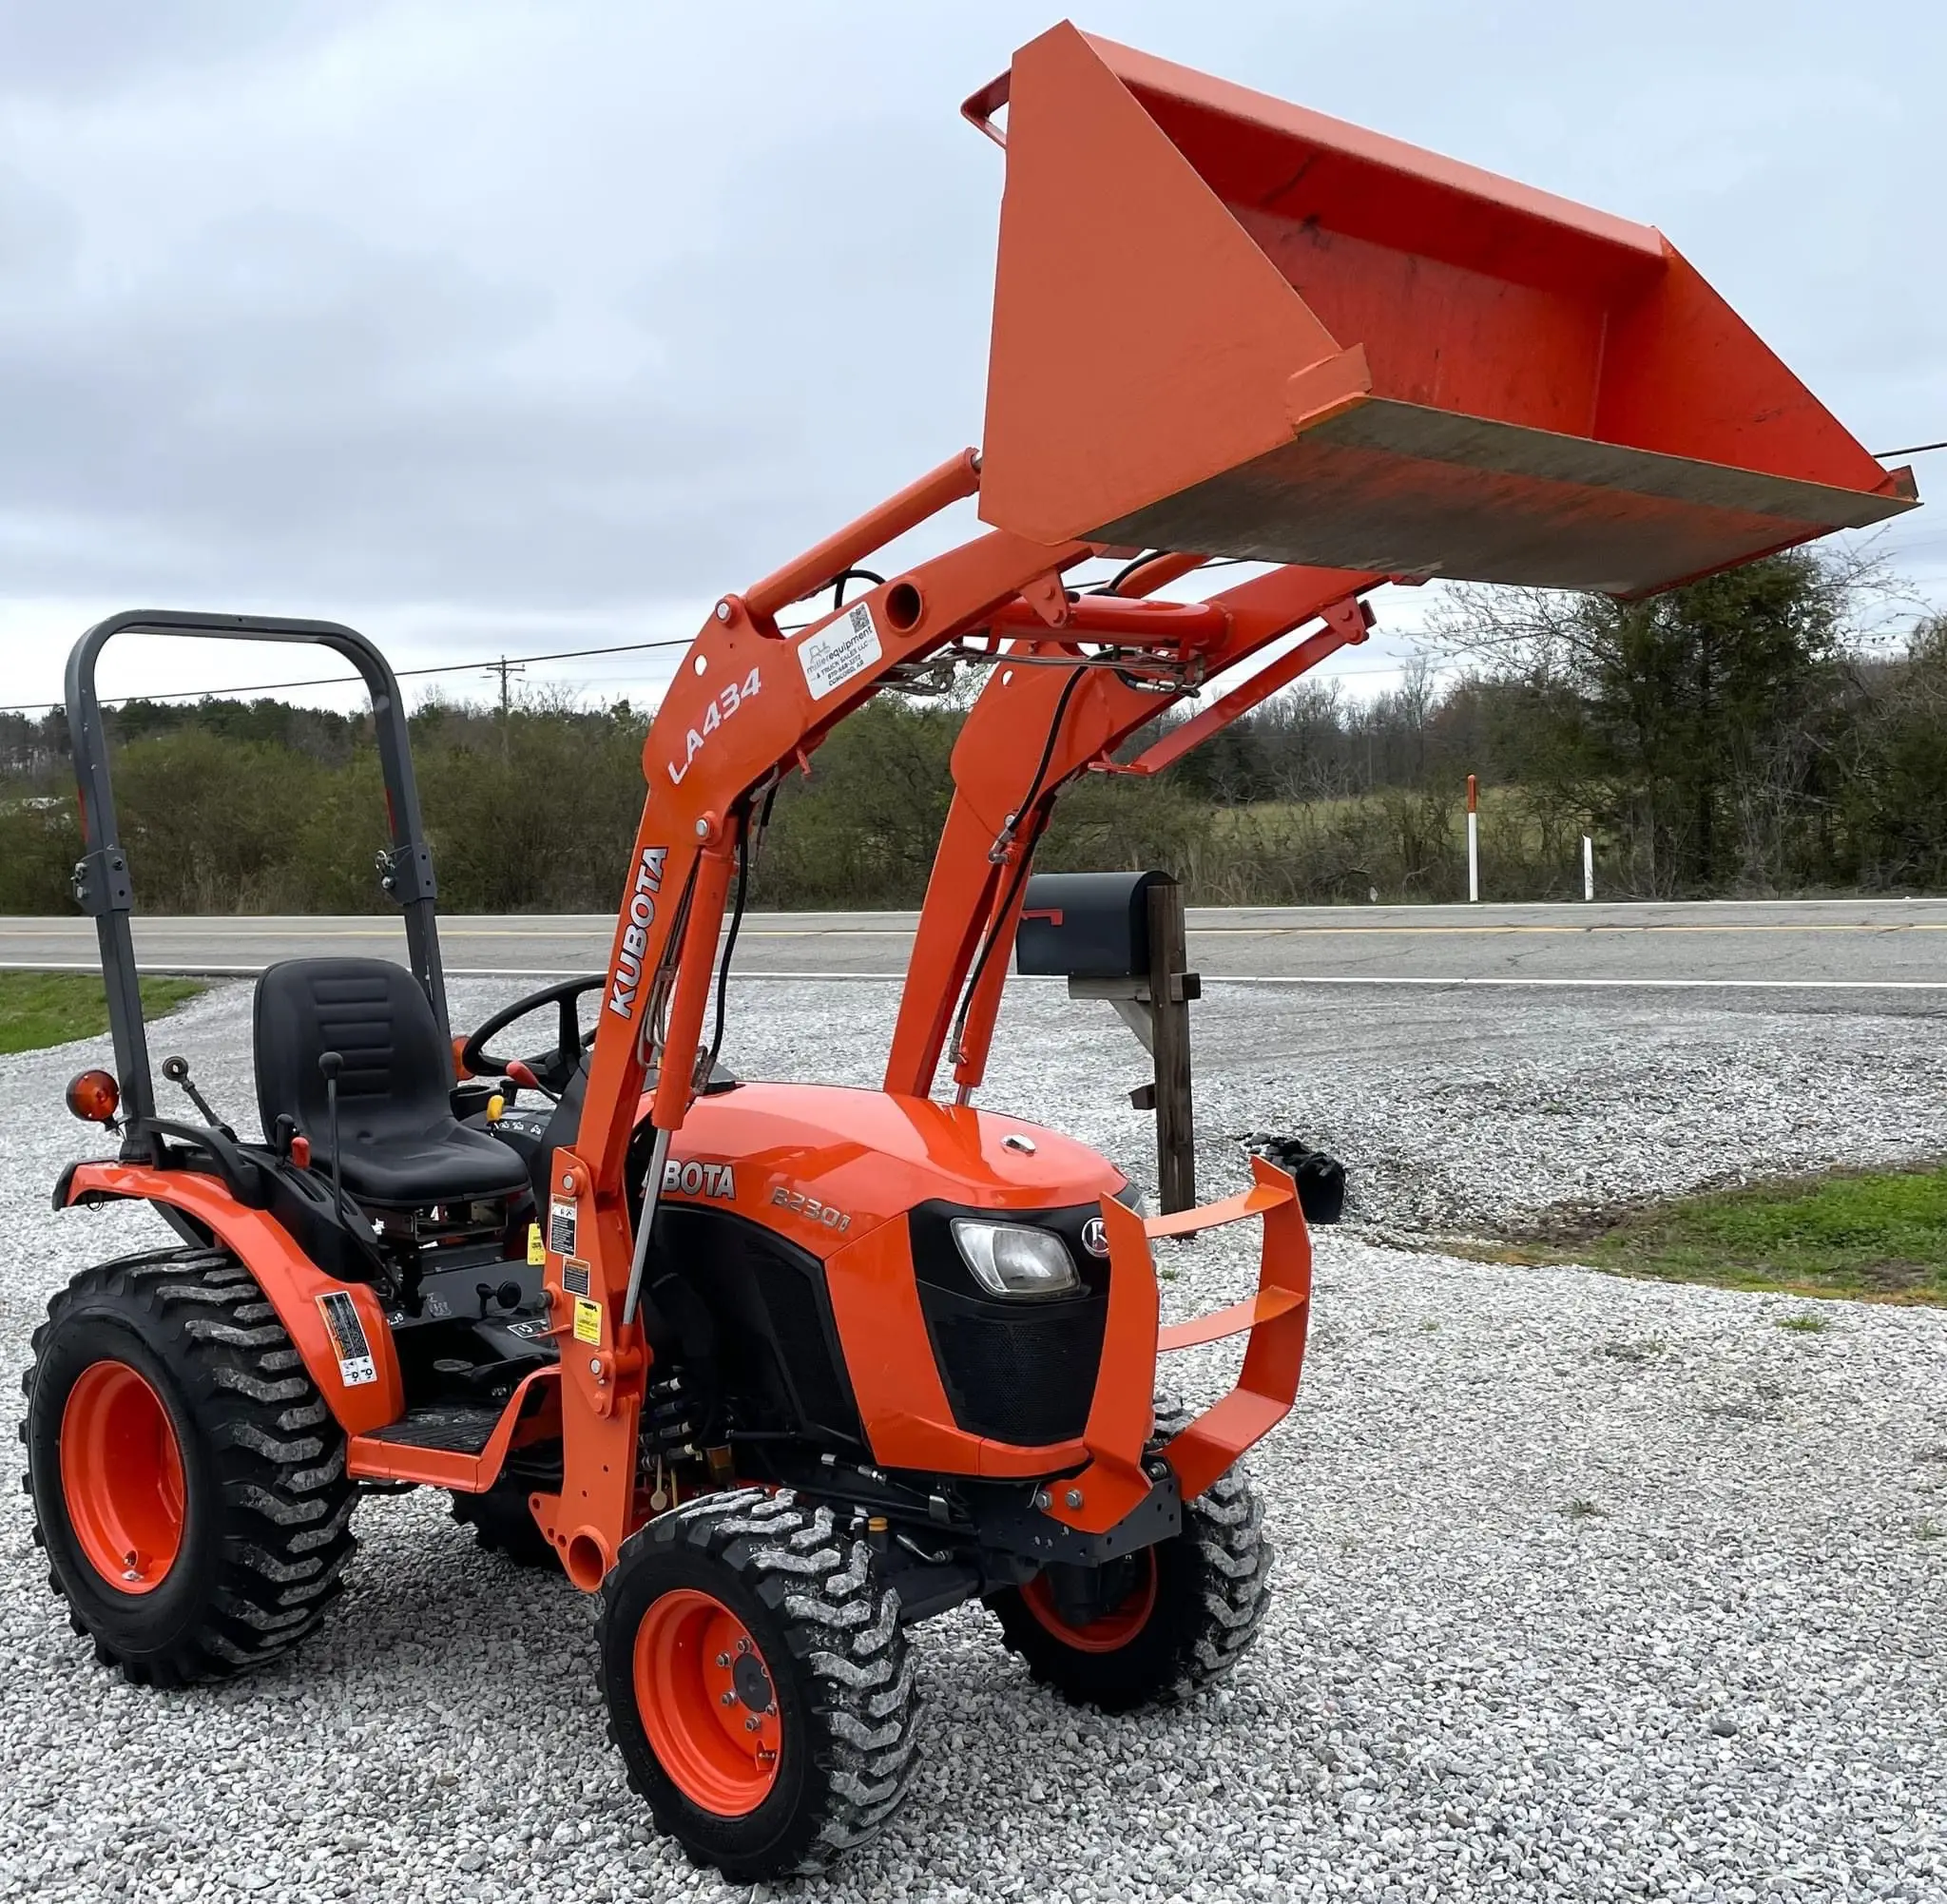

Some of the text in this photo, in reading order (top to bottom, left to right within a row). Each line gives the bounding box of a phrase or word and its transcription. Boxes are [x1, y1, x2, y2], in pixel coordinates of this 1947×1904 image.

[667, 666, 761, 786] LA434
[608, 846, 669, 1020] KUBOTA
[660, 1160, 736, 1200] BOTA
